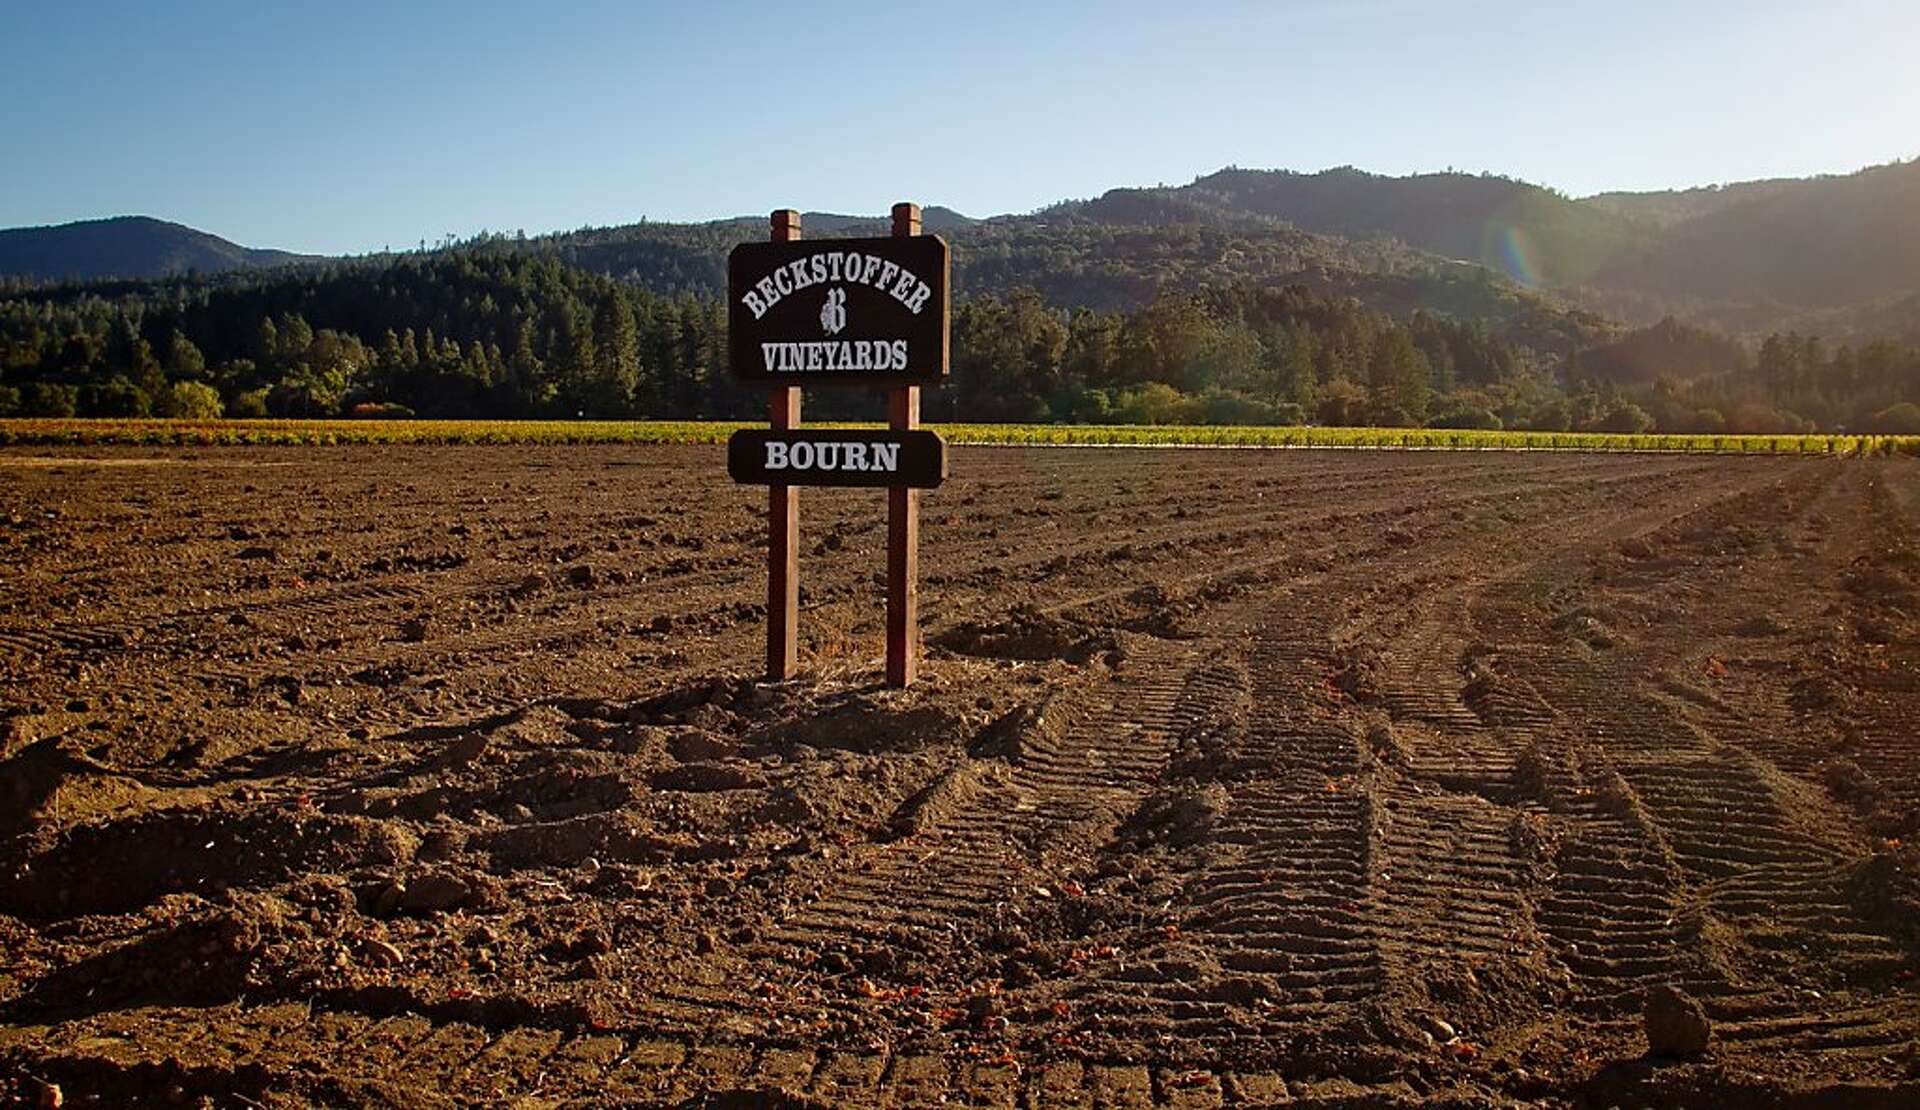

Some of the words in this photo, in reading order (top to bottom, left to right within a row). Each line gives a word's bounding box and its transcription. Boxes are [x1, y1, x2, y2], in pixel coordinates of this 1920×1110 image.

[742, 252, 931, 320] BECKSTOFFER
[761, 340, 908, 371] VINEYARDS
[764, 442, 901, 471] BOURN
